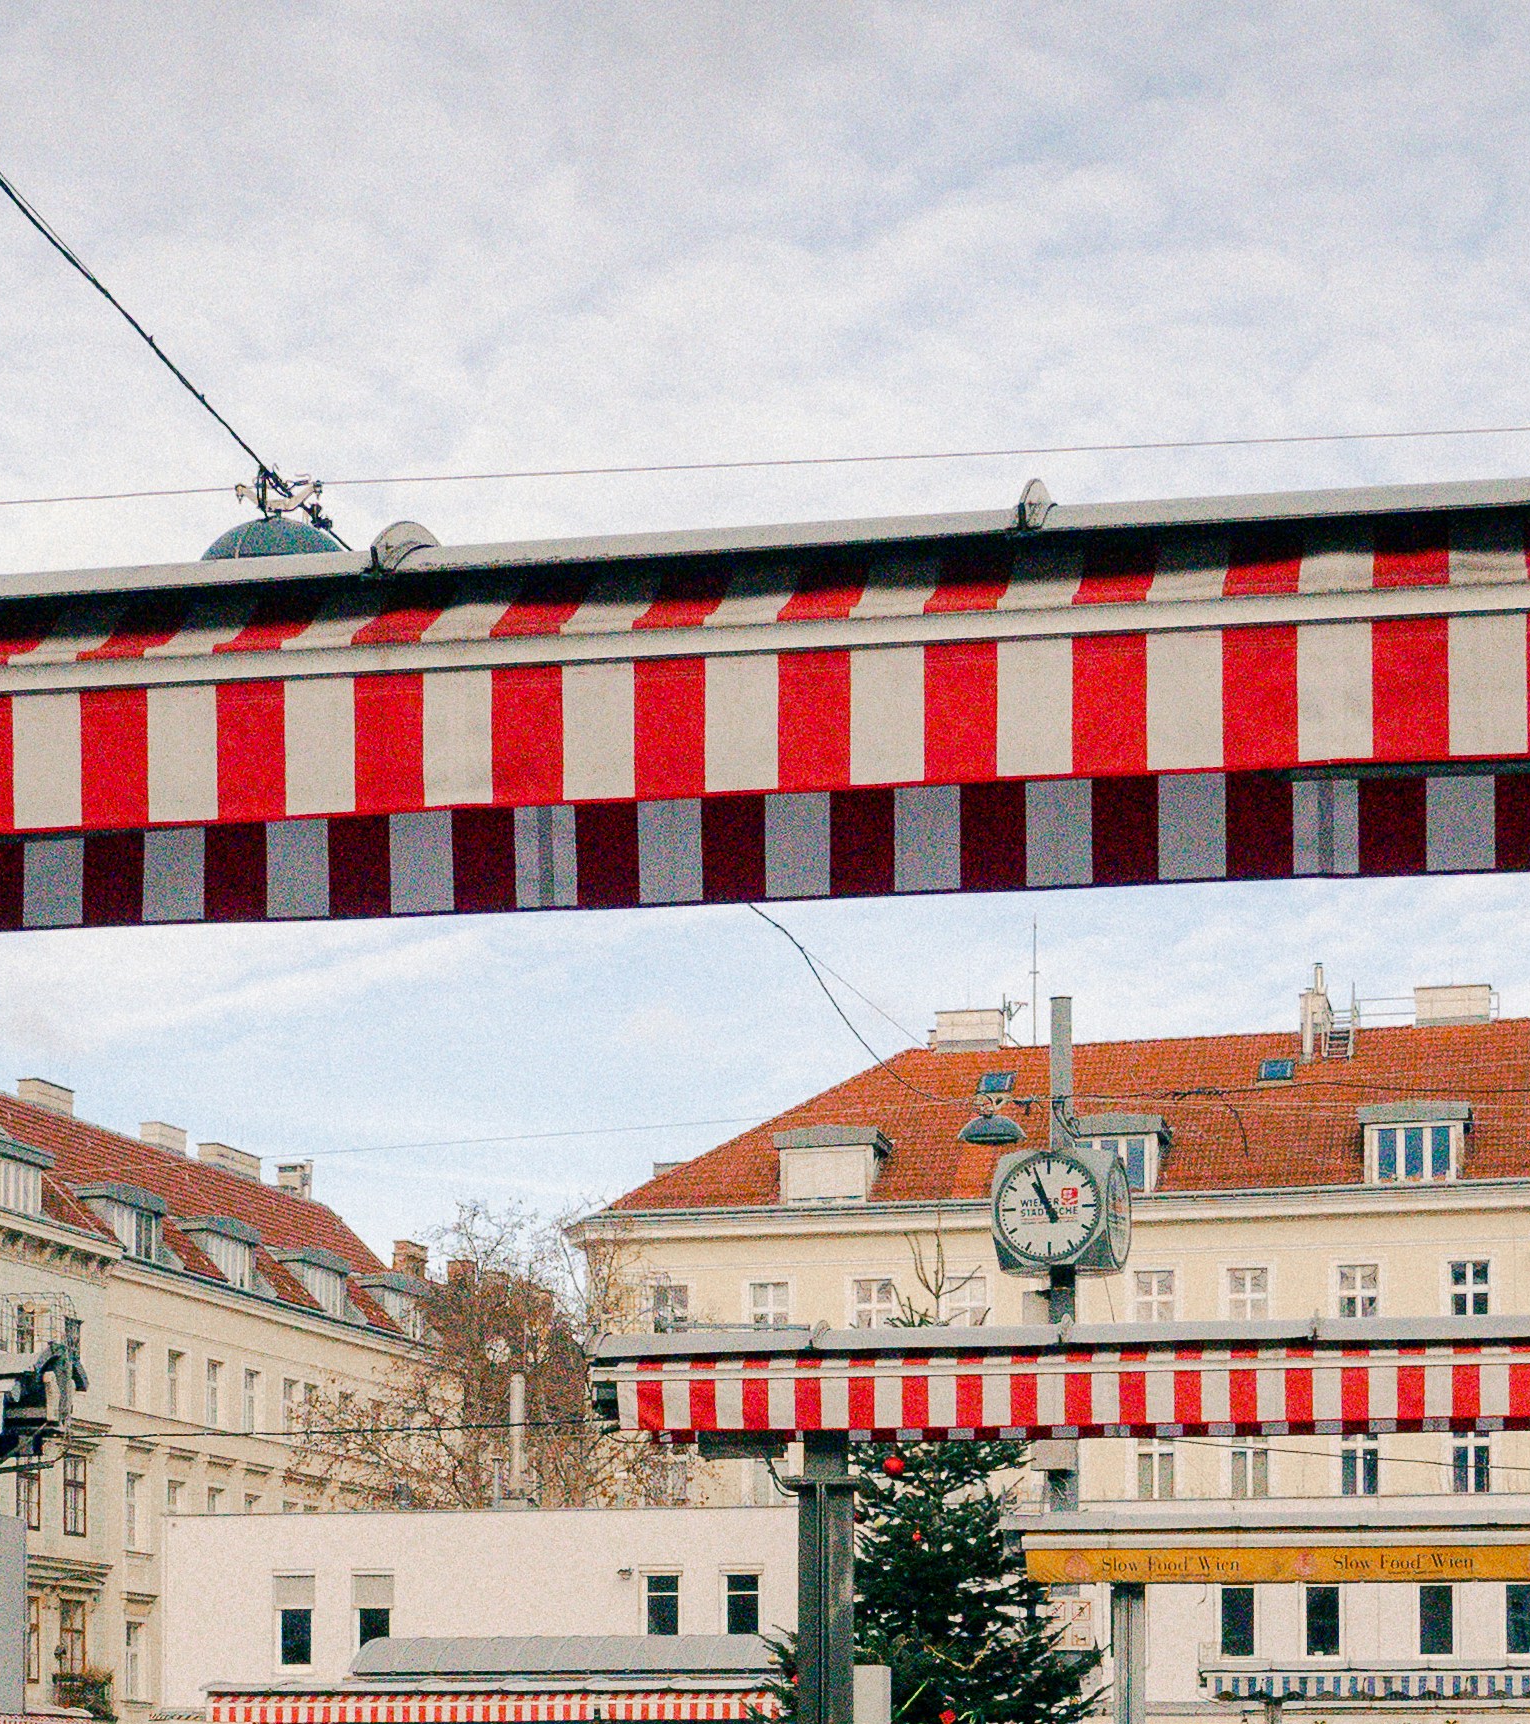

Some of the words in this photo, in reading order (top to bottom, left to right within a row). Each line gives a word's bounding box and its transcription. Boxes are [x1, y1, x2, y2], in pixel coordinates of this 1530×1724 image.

[1020, 1197, 1059, 1207] WIEER
[1102, 1556, 1138, 1572] Slow
[1197, 1556, 1239, 1572] Wien
[1333, 1554, 1370, 1570] Slow
[1430, 1553, 1473, 1570] Wien
